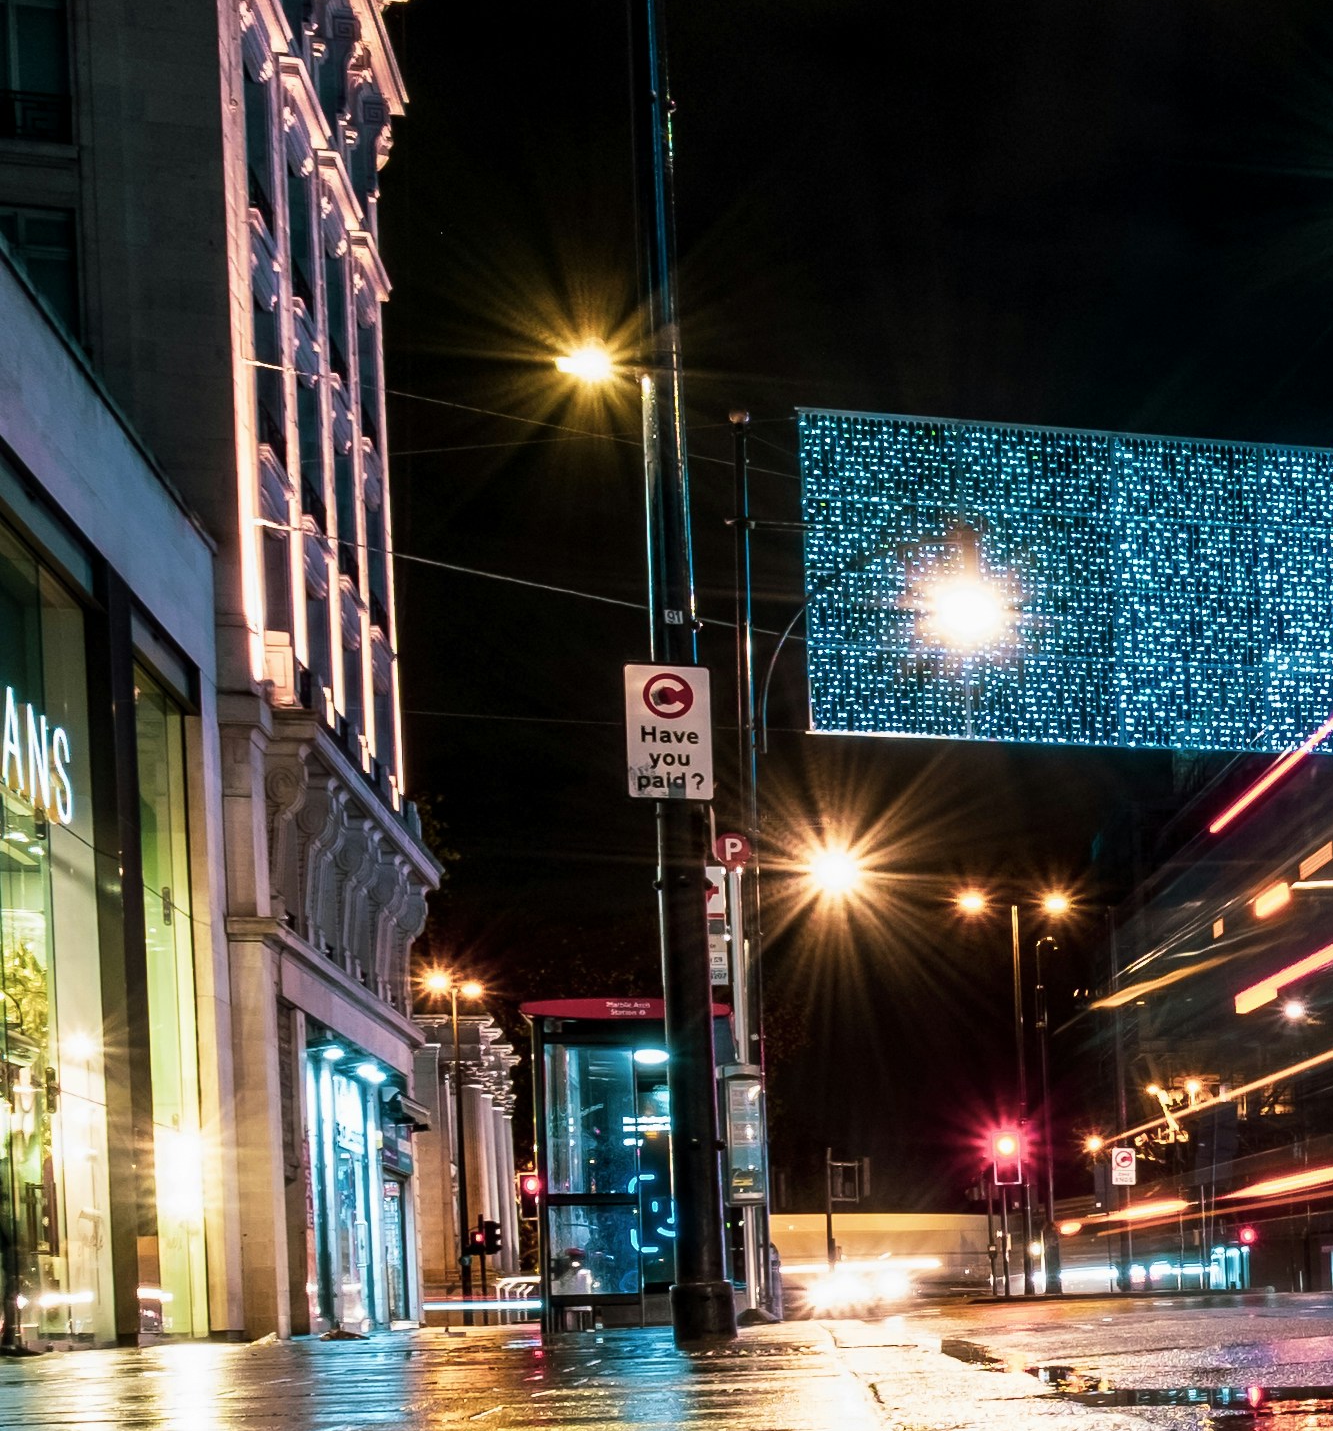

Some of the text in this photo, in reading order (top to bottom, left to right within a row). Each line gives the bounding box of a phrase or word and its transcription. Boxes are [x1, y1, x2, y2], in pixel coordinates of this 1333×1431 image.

[641, 726, 699, 744] Have
[649, 753, 691, 768] you
[725, 838, 742, 860] P
